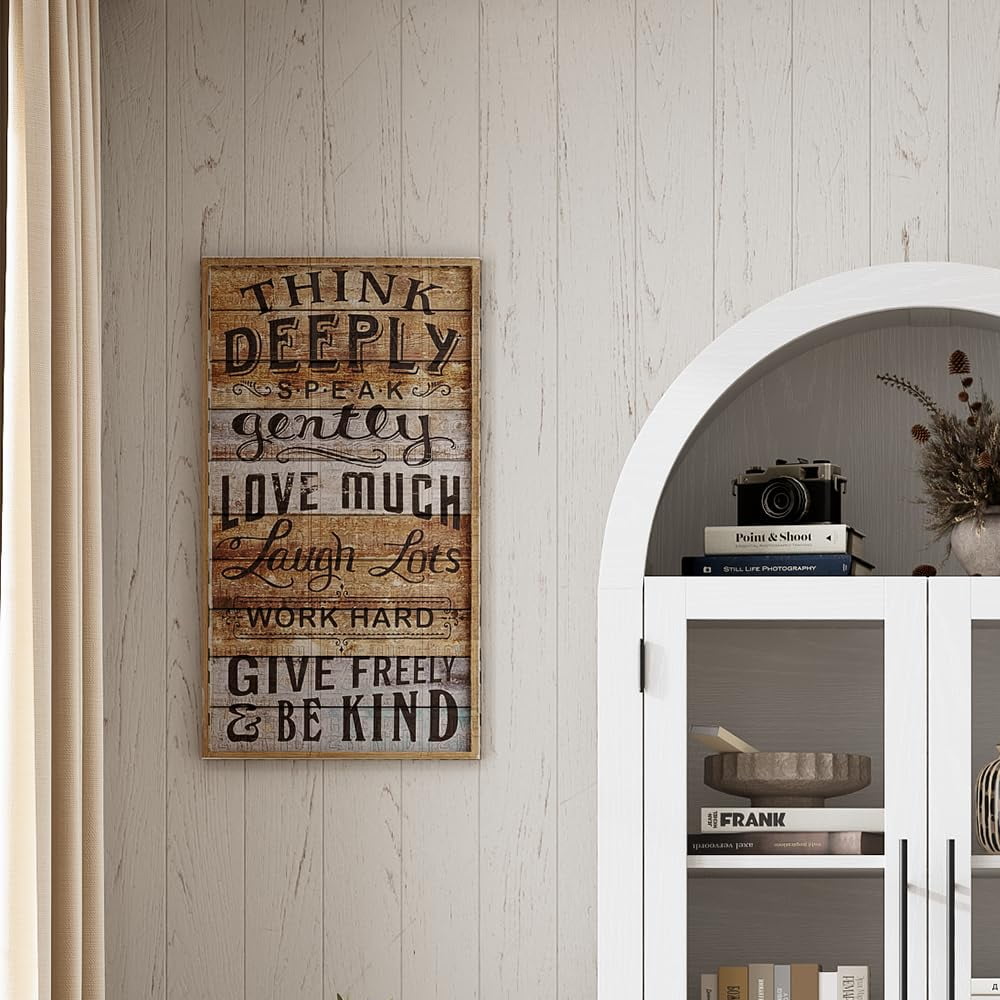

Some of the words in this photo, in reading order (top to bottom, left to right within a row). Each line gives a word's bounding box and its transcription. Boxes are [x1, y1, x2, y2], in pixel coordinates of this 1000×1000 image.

[240, 270, 443, 316] THINK
[224, 314, 462, 376] DEEPLY
[232, 403, 455, 467] gently
[222, 471, 319, 531] LOVE
[342, 471, 461, 530] MUCH
[217, 518, 356, 592] Laugh
[368, 529, 460, 583] Lots
[736, 532, 765, 543] Point
[768, 531, 778, 542] &
[779, 530, 812, 542] Shoot
[246, 607, 338, 629] WORK
[350, 607, 434, 629] HARD
[227, 655, 335, 696] GIVE
[352, 656, 456, 689] FREELY
[226, 703, 262, 742] &
[277, 697, 322, 743] BE
[342, 689, 459, 742] KIND
[720, 812, 786, 828] FRANK
[736, 842, 754, 850] axel
